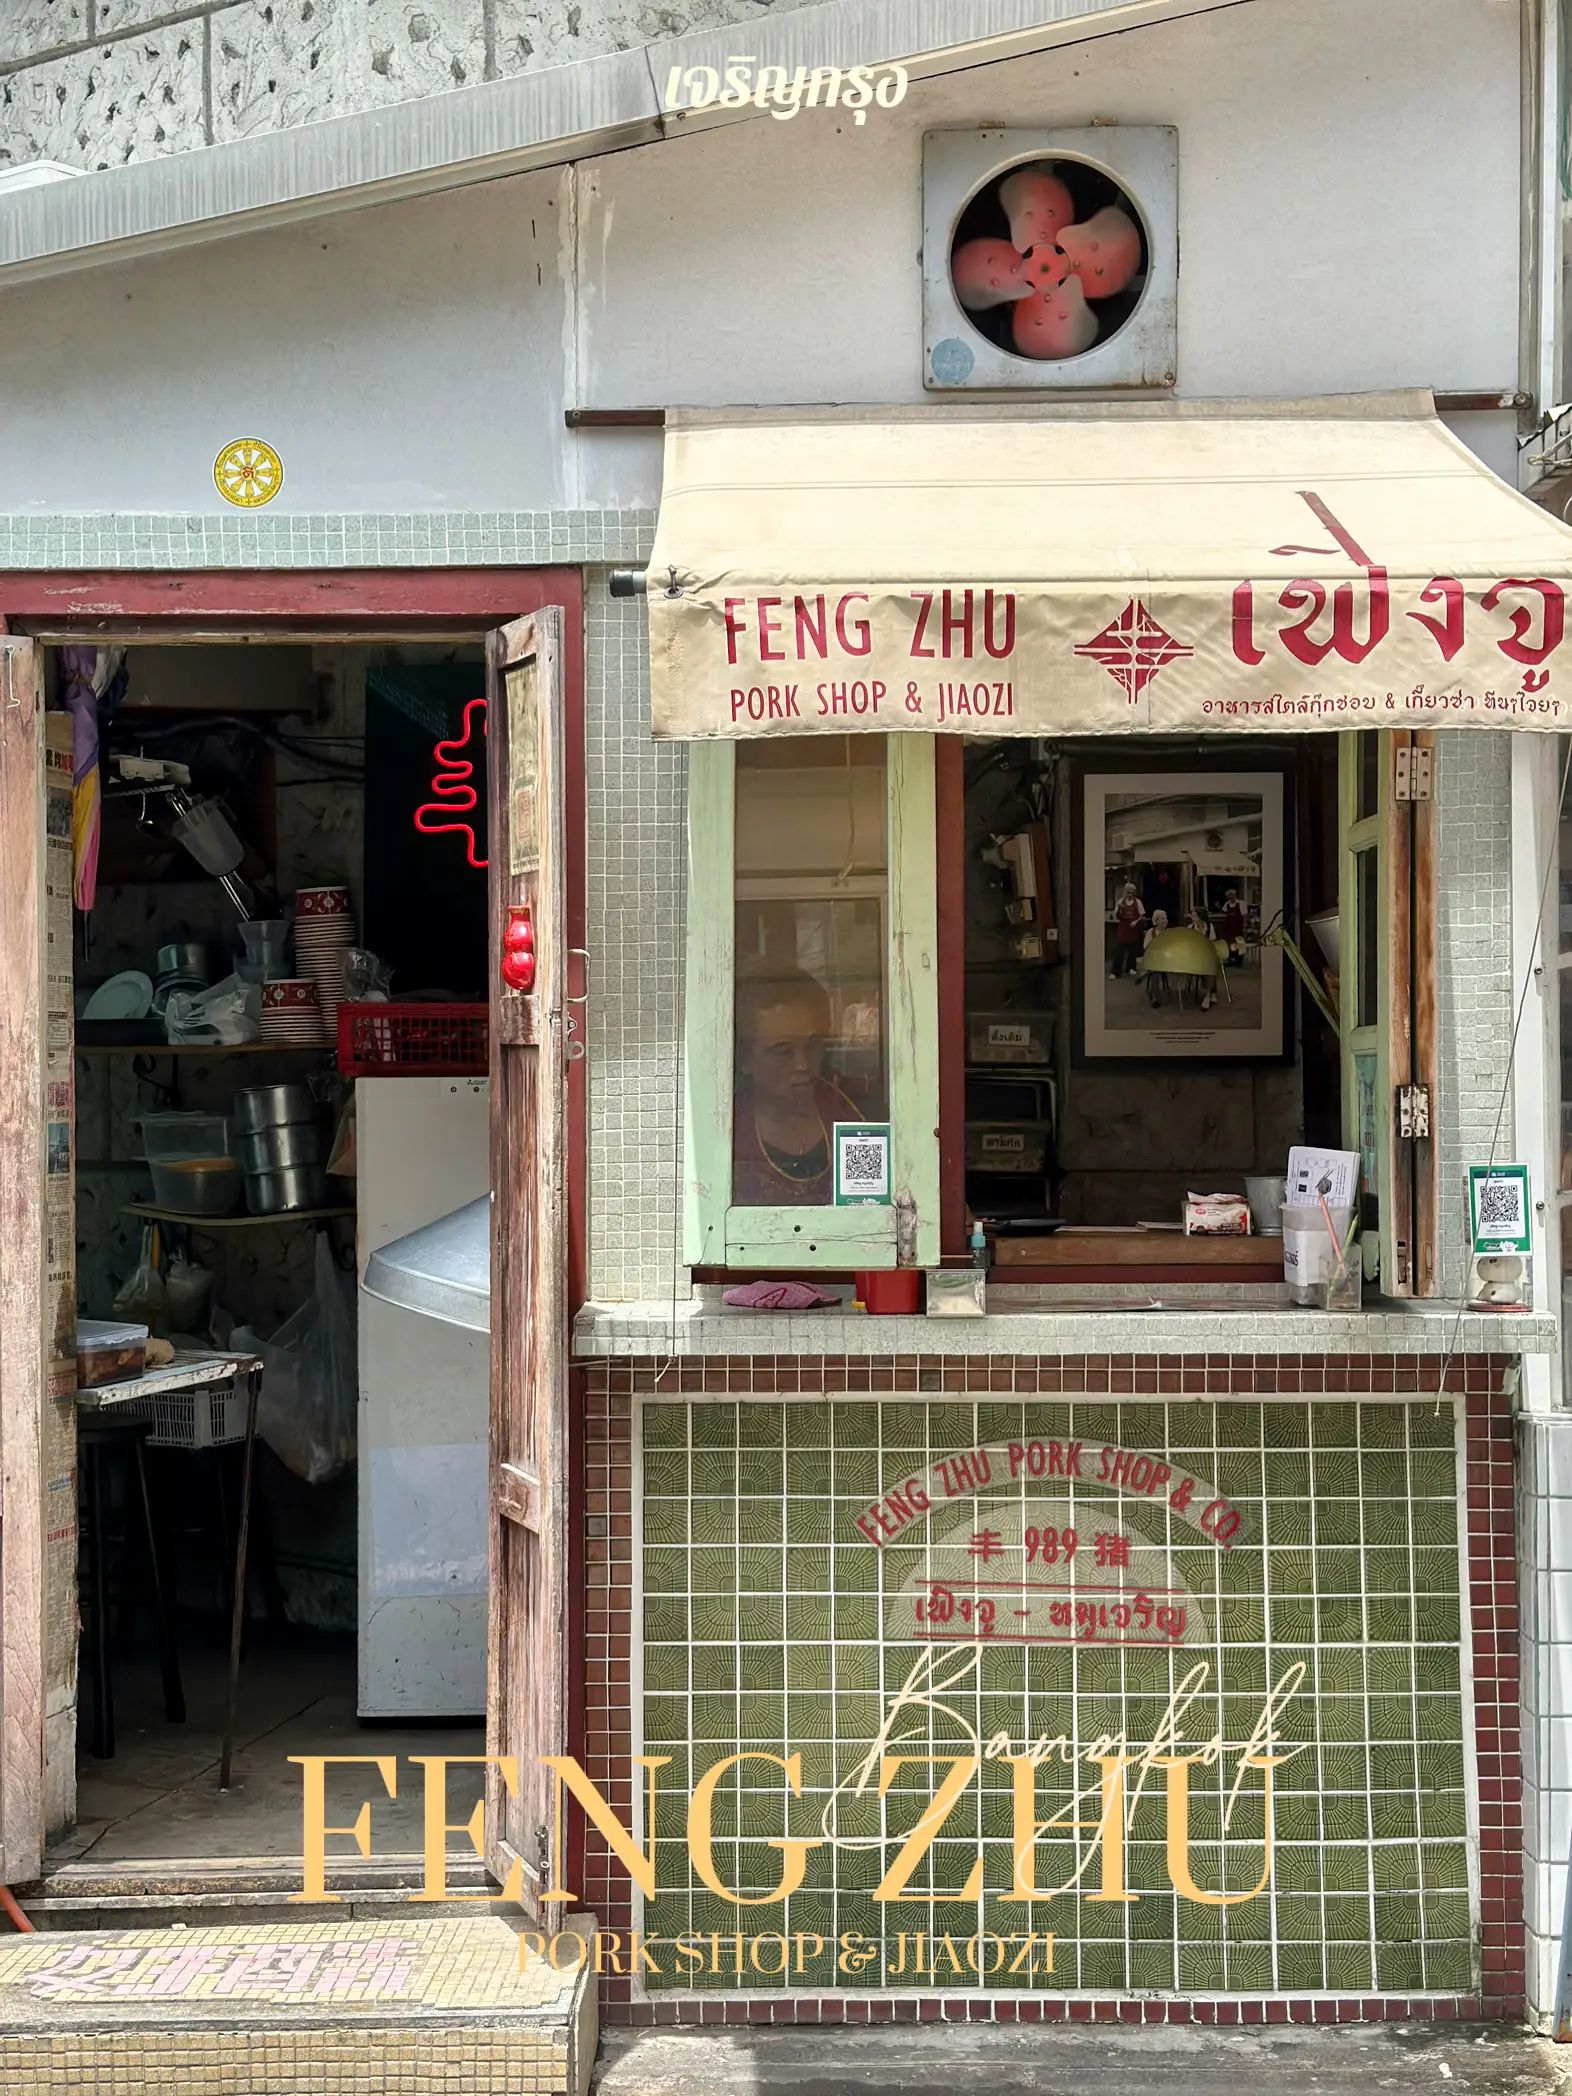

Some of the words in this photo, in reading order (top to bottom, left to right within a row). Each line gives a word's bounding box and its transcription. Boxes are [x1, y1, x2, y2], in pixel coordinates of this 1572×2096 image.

[723, 591, 872, 665] FENG
[909, 588, 1016, 660] ZHU
[730, 683, 801, 723] PORK
[816, 680, 887, 716] SHOP
[904, 681, 923, 713] &
[937, 681, 1014, 723] JIAOZI
[1384, 692, 1395, 710] &
[856, 1479, 931, 1547] FENG
[934, 1448, 991, 1498] ZHU
[1007, 1441, 1083, 1479] PORK
[1096, 1446, 1172, 1496] SHOP
[1168, 1477, 1195, 1513] &
[966, 1527, 1004, 1565] 丰
[1023, 1526, 1078, 1565] 989
[1092, 1531, 1132, 1568] 猪
